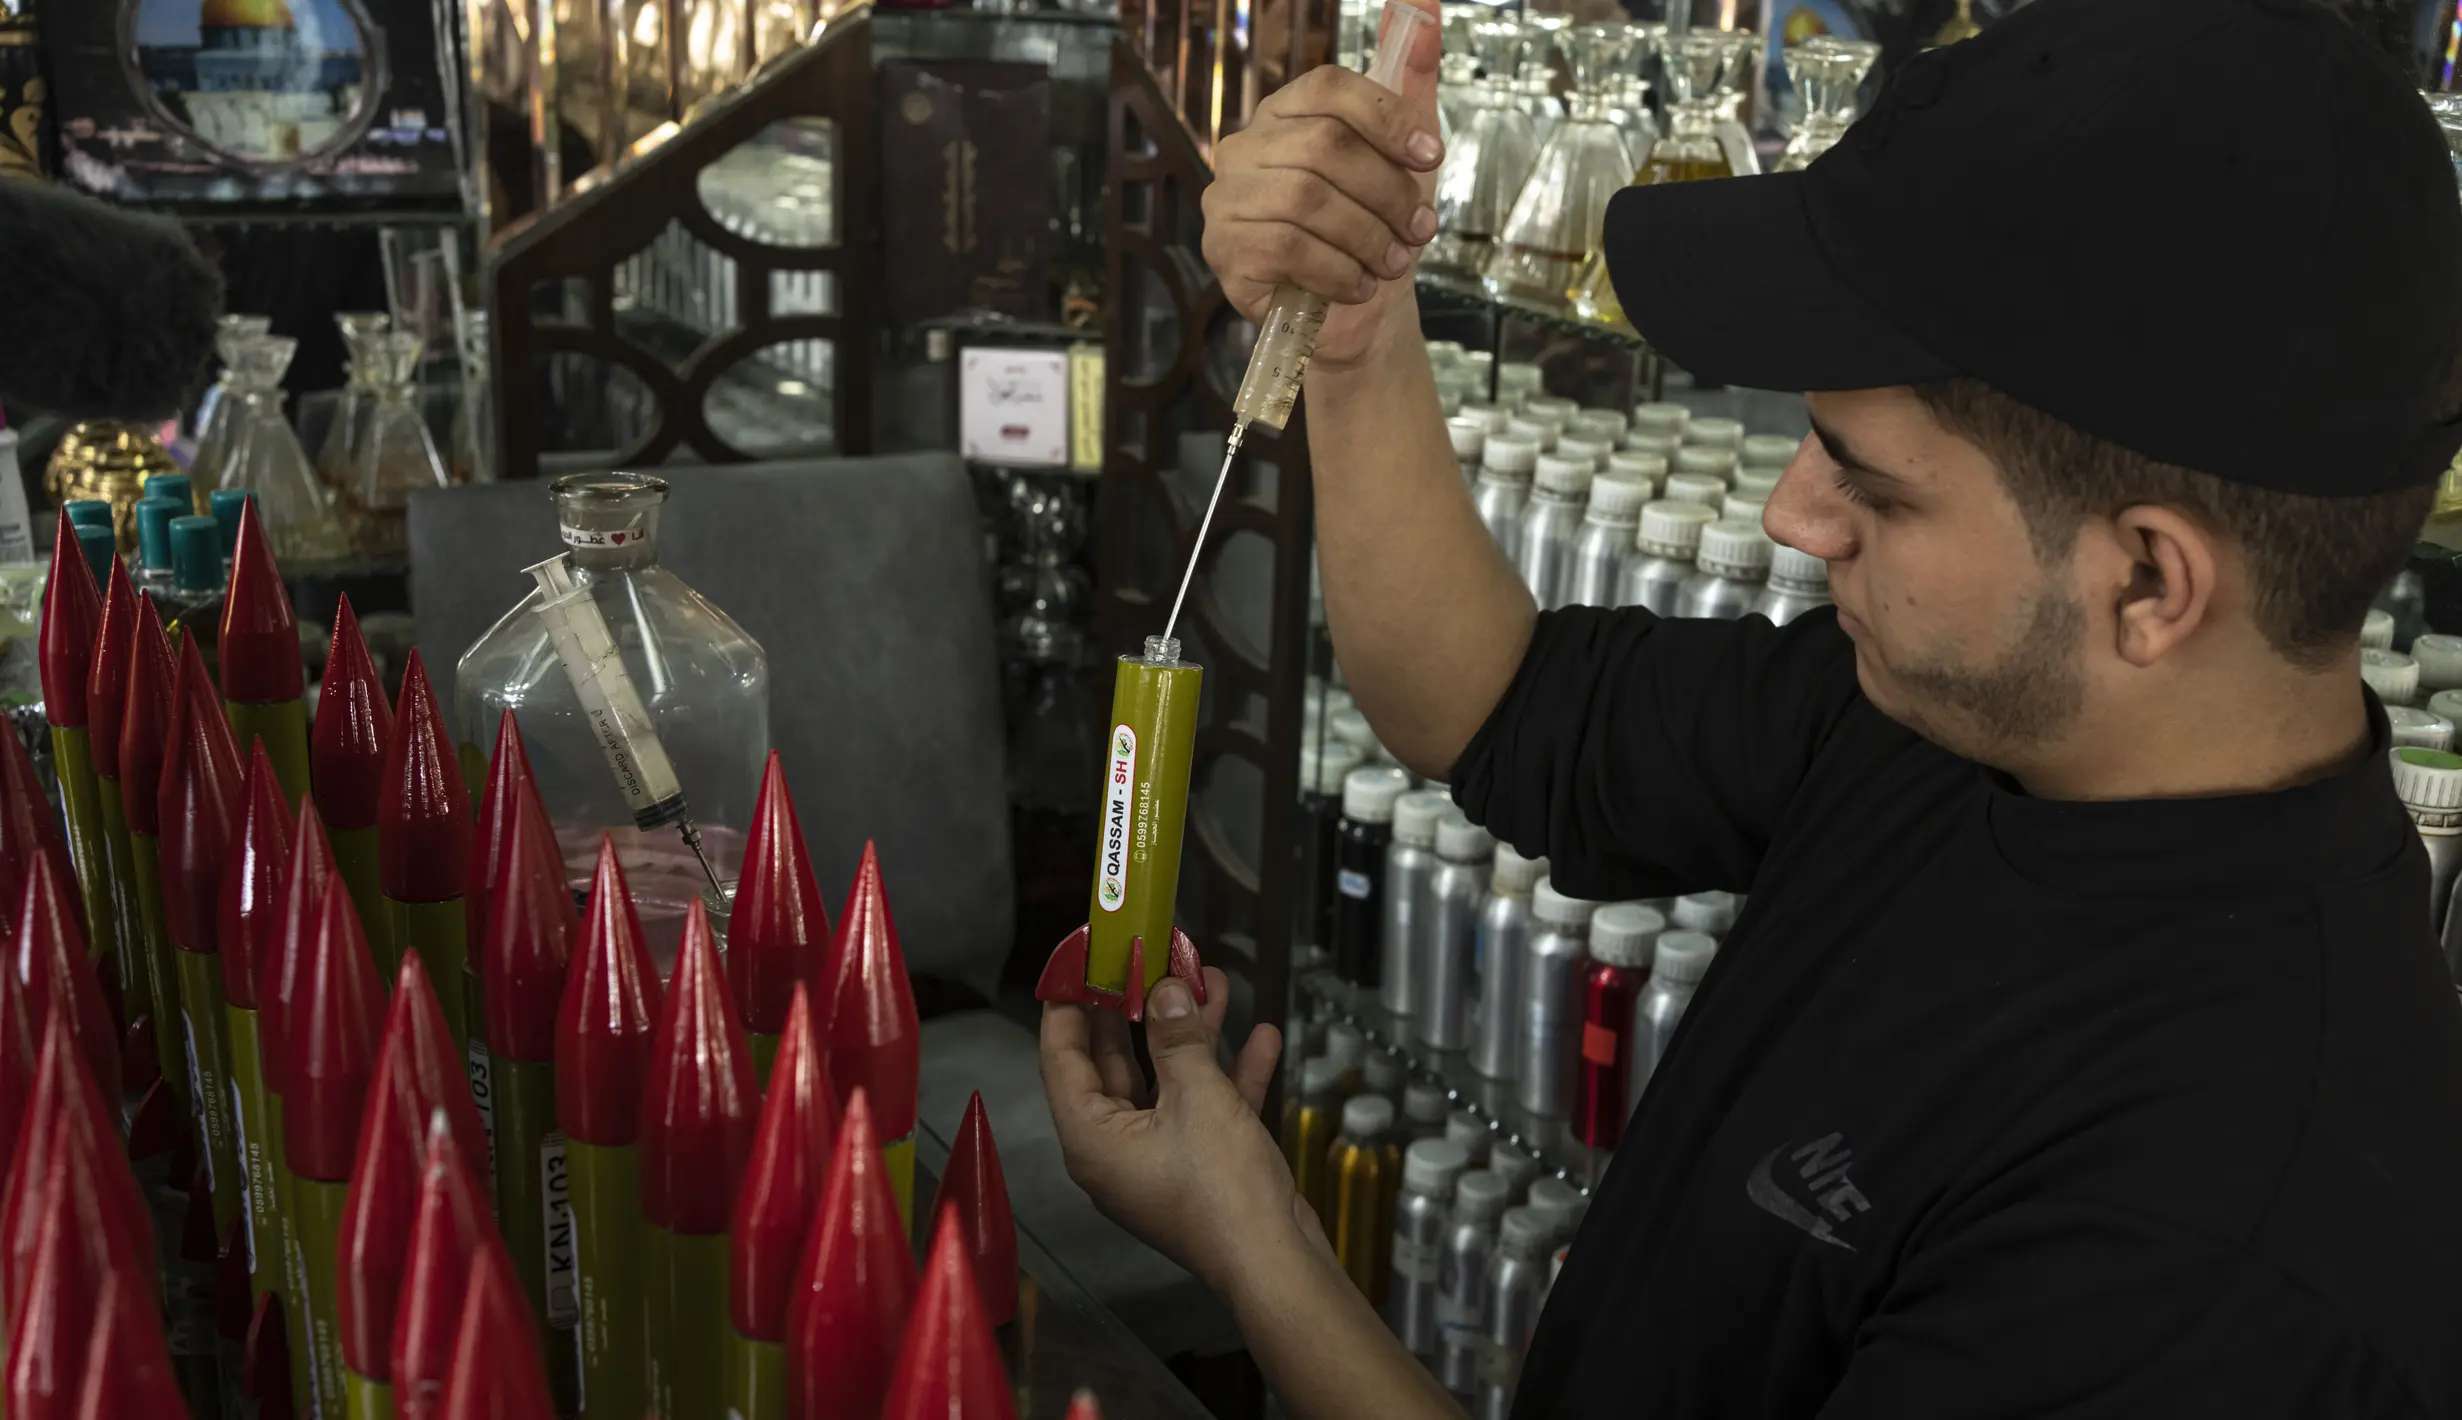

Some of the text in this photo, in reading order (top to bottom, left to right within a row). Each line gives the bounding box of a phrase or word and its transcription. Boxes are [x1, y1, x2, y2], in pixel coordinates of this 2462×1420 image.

[599, 718, 621, 751] AFTER
[614, 753, 641, 796] DISCARD
[1115, 760, 1128, 785] SH
[1136, 781, 1151, 849] 0599768145
[1106, 799, 1125, 876] QASSAM
